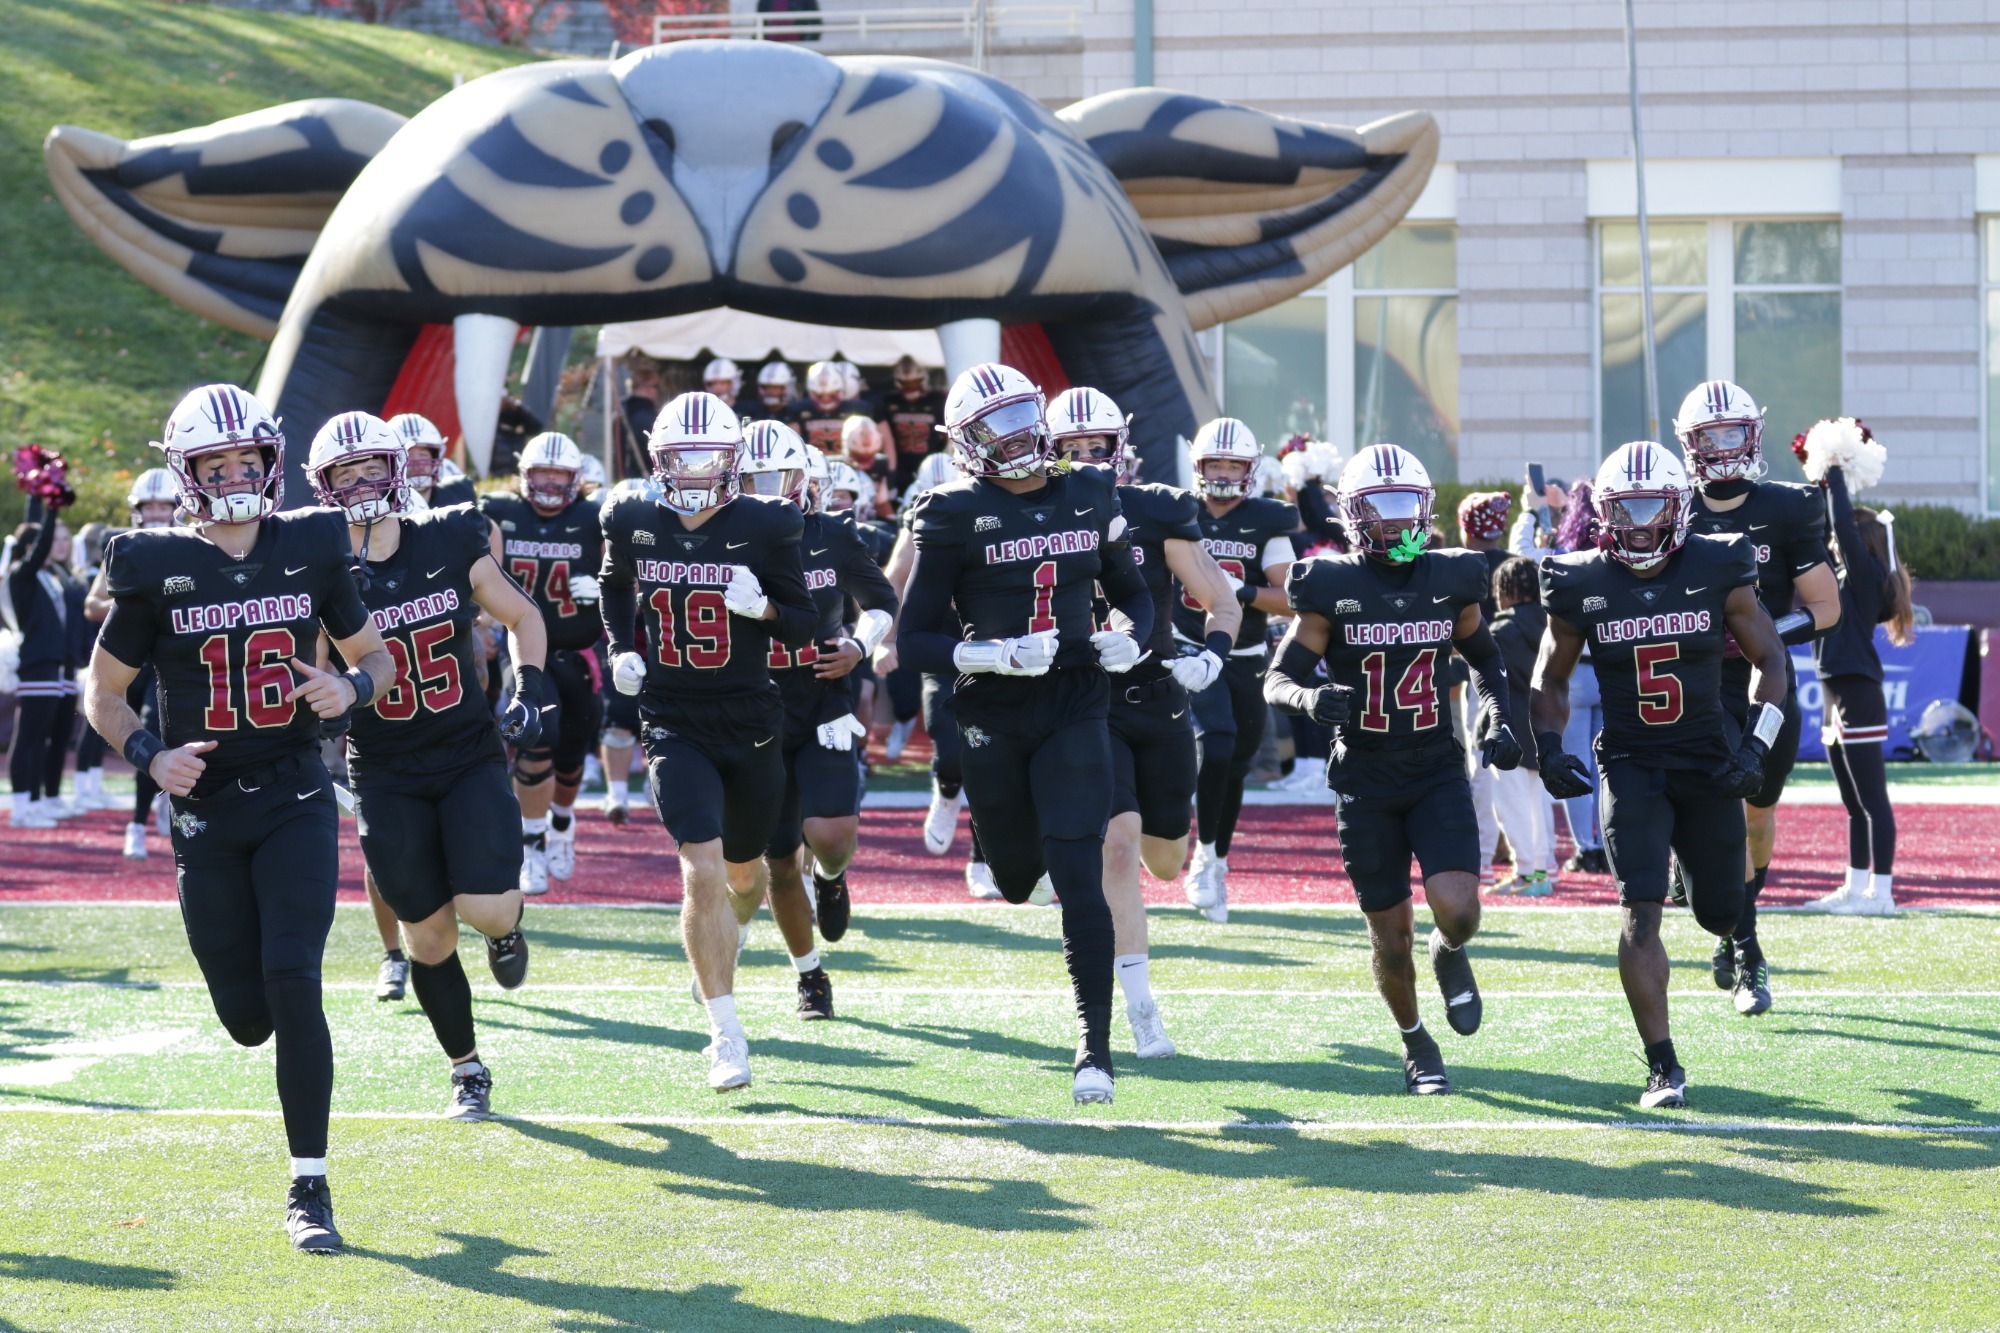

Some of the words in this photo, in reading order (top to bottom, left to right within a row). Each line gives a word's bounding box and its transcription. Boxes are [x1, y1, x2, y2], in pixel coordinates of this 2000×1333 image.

[505, 540, 582, 558] LEOPARDS
[985, 530, 1100, 565] LEOPARDS
[1201, 538, 1257, 559] PARDS
[511, 558, 577, 618] 74
[637, 560, 735, 586] LEOPARD
[172, 593, 311, 634] LEOPARDS
[371, 588, 459, 632] OPARDS
[1028, 561, 1057, 635] 1
[650, 587, 731, 669] 19
[1345, 620, 1453, 645] LEOPARDS
[1596, 610, 1711, 643] LEOPARDS
[200, 628, 297, 731] 16
[1360, 648, 1440, 733] 14
[1634, 641, 1684, 725] 5
